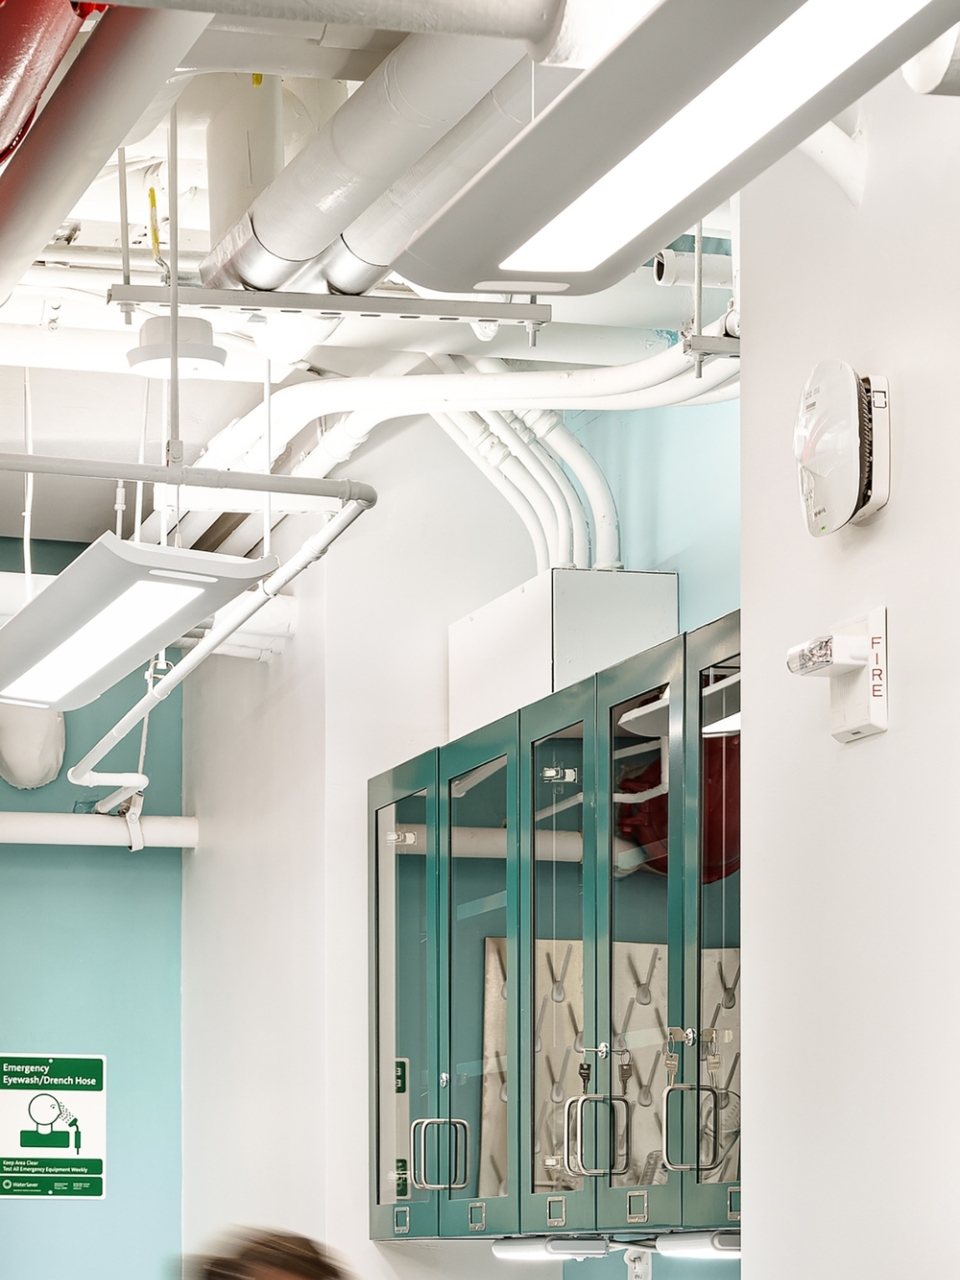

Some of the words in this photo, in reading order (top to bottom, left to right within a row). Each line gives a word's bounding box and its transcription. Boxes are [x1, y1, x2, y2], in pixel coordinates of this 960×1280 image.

[871, 636, 883, 697] FIRE
[3, 1063, 50, 1075] Emergency
[3, 1075, 73, 1086] Eyewash/Drench
[75, 1076, 97, 1086] Hose
